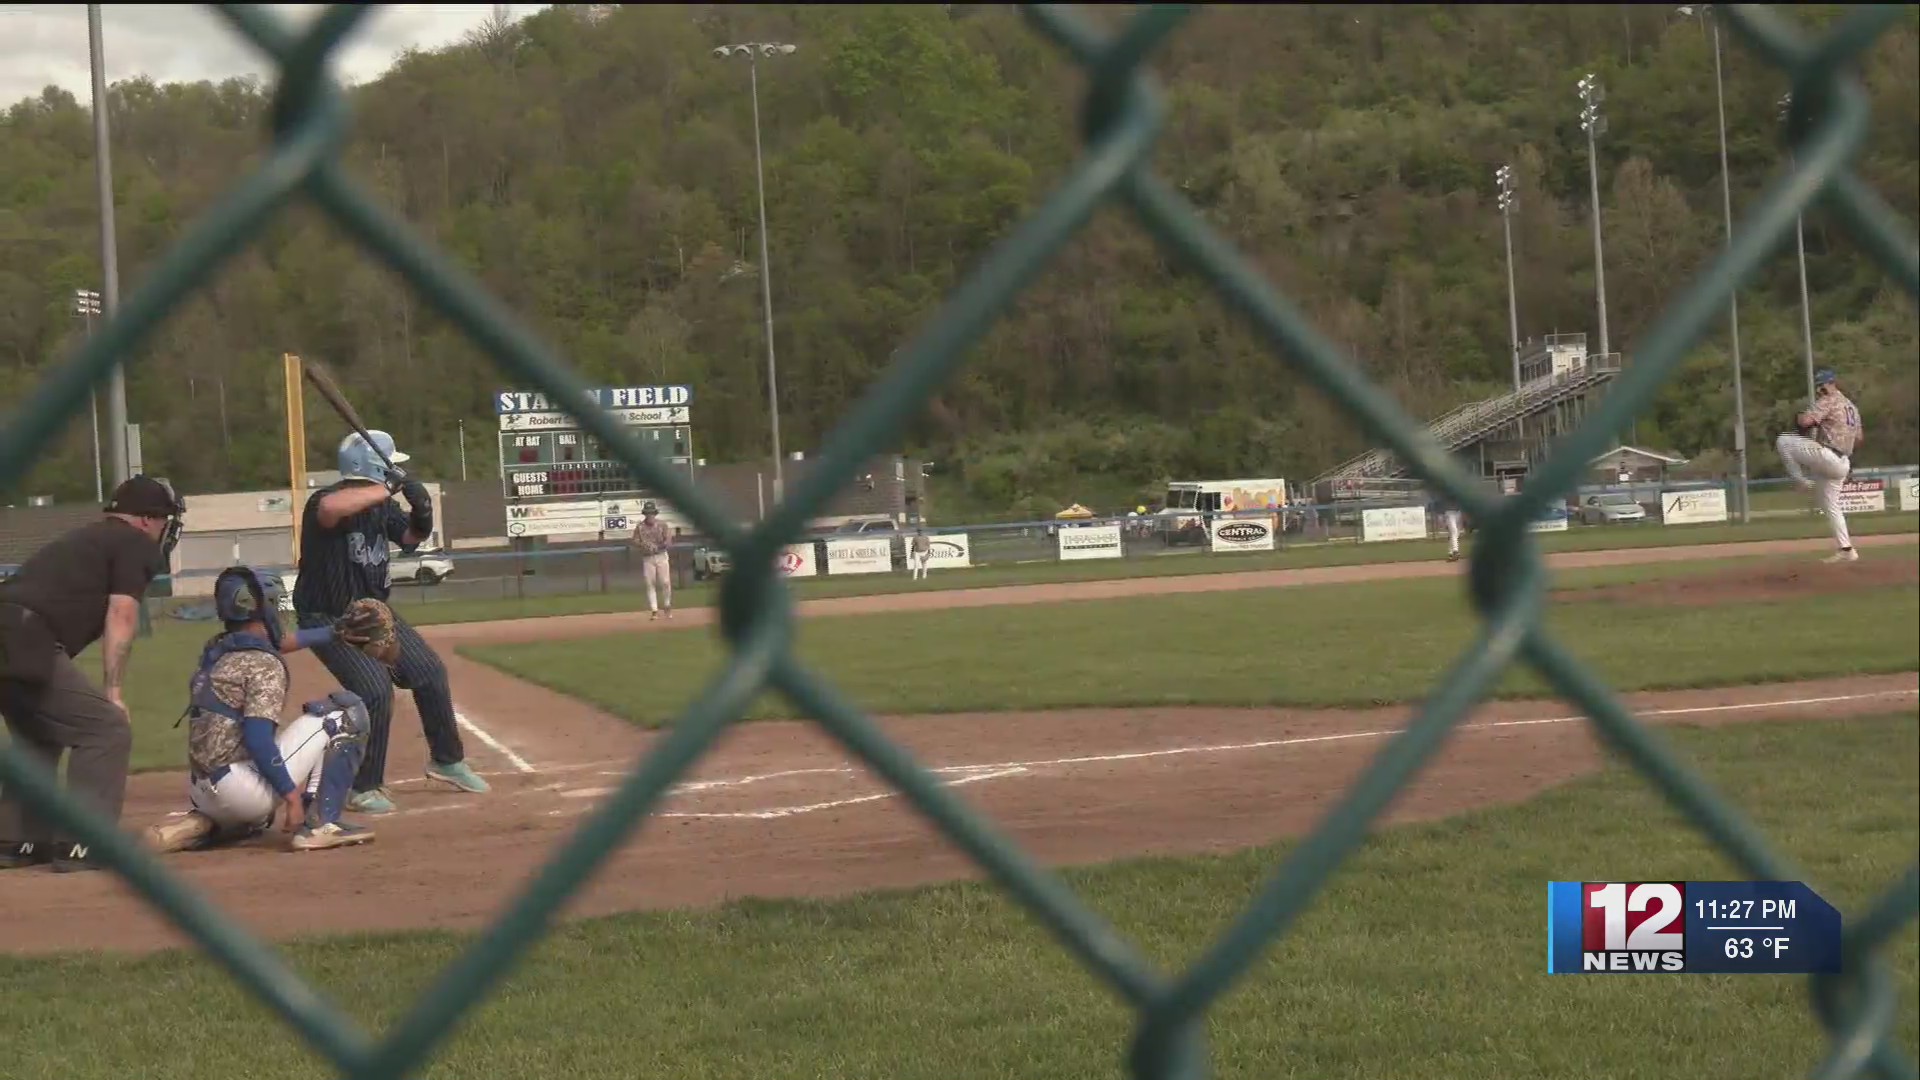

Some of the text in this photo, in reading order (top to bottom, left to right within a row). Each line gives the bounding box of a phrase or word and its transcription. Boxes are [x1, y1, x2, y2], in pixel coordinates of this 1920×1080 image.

[612, 387, 688, 406] FIELD
[529, 416, 561, 425] Robert
[628, 411, 661, 421] School
[559, 435, 576, 445] BALL
[513, 472, 548, 483] GUESTS
[518, 484, 544, 496] HOME
[1220, 528, 1267, 537] CENTRAL
